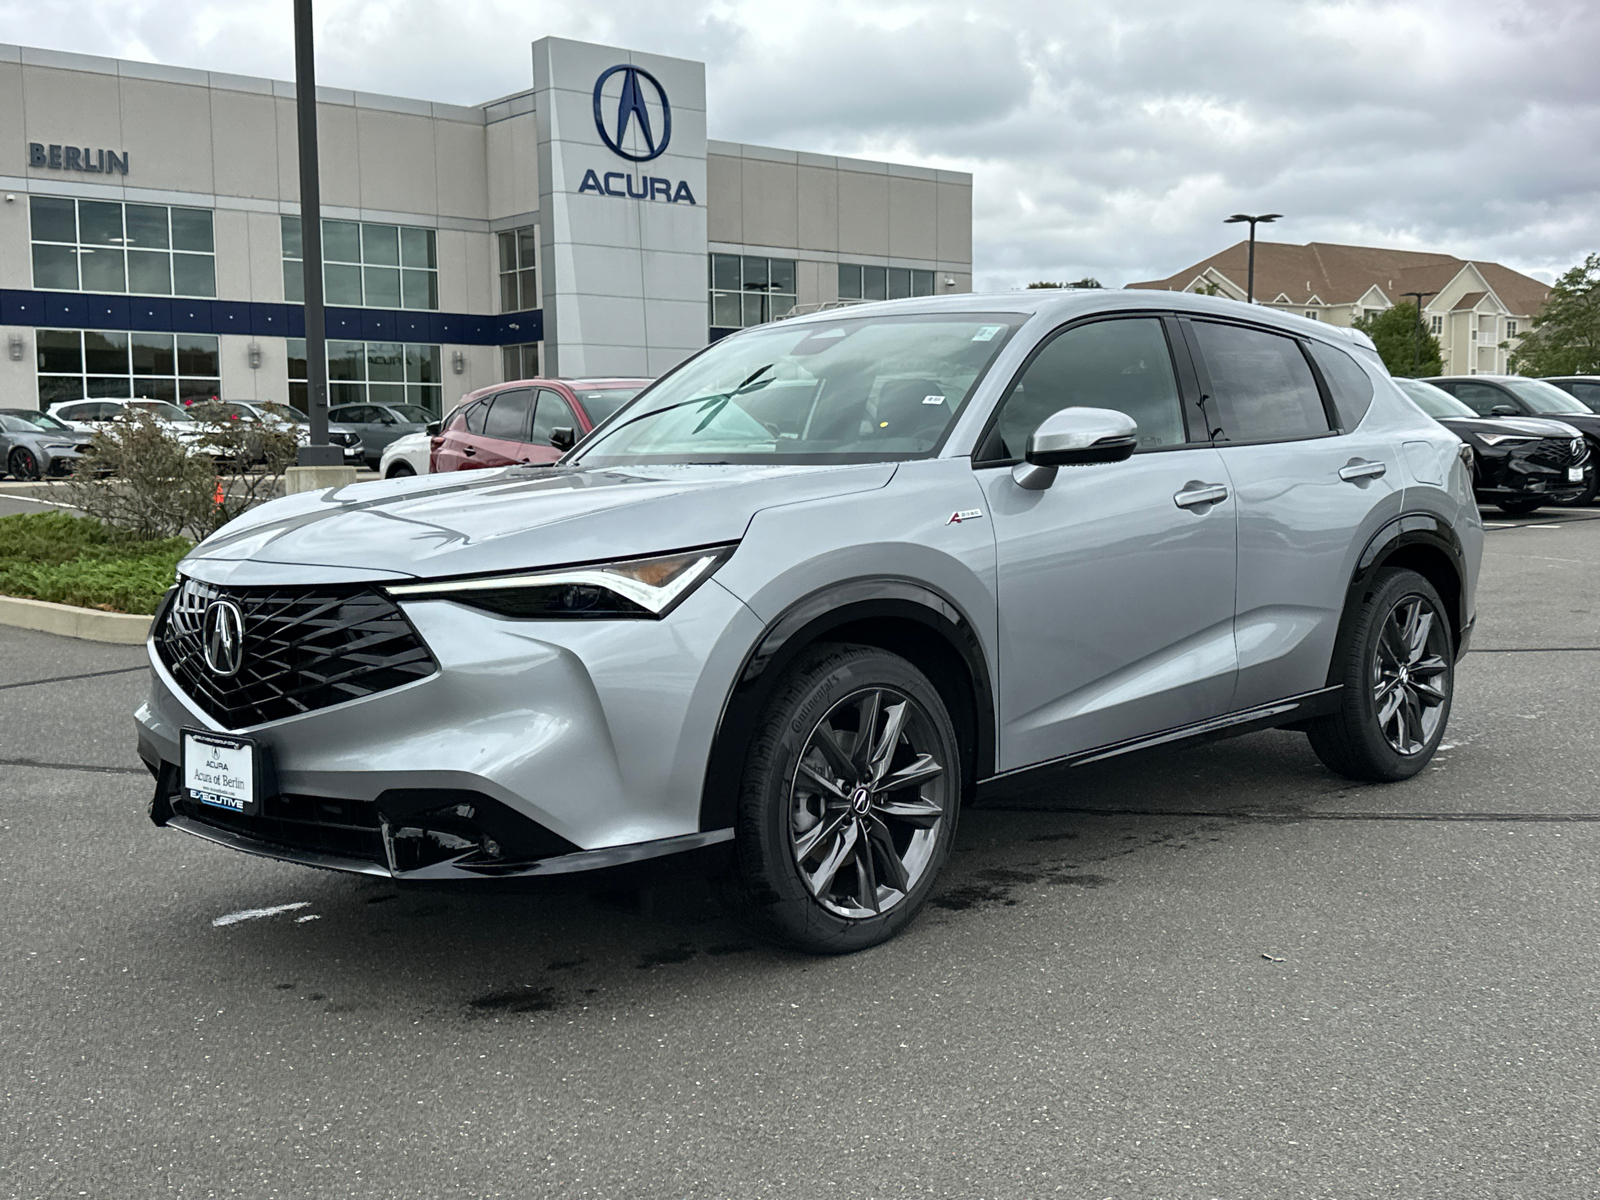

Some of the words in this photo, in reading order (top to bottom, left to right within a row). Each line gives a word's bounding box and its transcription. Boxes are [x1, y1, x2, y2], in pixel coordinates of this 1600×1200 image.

[29, 142, 129, 175] BERLIN
[578, 169, 696, 205] ACURA
[206, 760, 229, 771] ACURA
[194, 769, 212, 783] Acura
[213, 774, 221, 786] of
[222, 774, 245, 790] Berlin
[190, 789, 244, 809] EXECUTIVE
